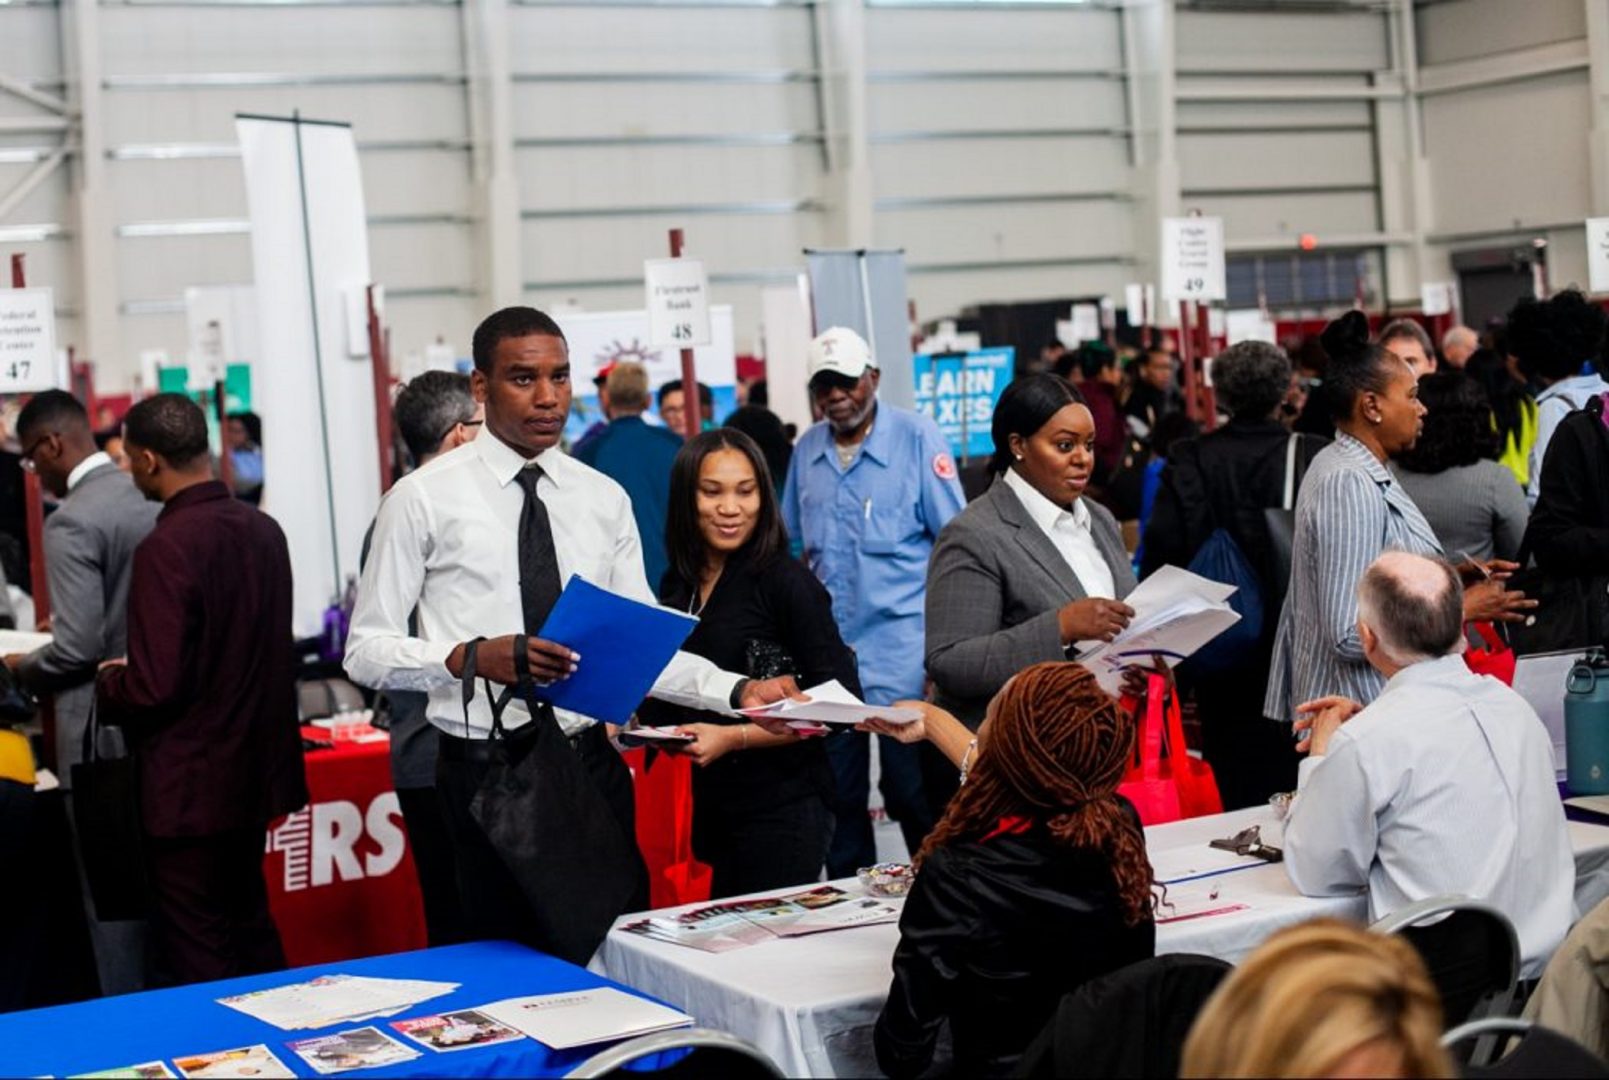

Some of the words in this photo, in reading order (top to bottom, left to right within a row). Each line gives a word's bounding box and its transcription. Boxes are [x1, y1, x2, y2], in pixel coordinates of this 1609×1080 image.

[1184, 278, 1204, 292] 49
[0, 309, 36, 319] ederal
[672, 322, 692, 339] 48
[5, 360, 31, 379] 47
[915, 368, 995, 398] EARN
